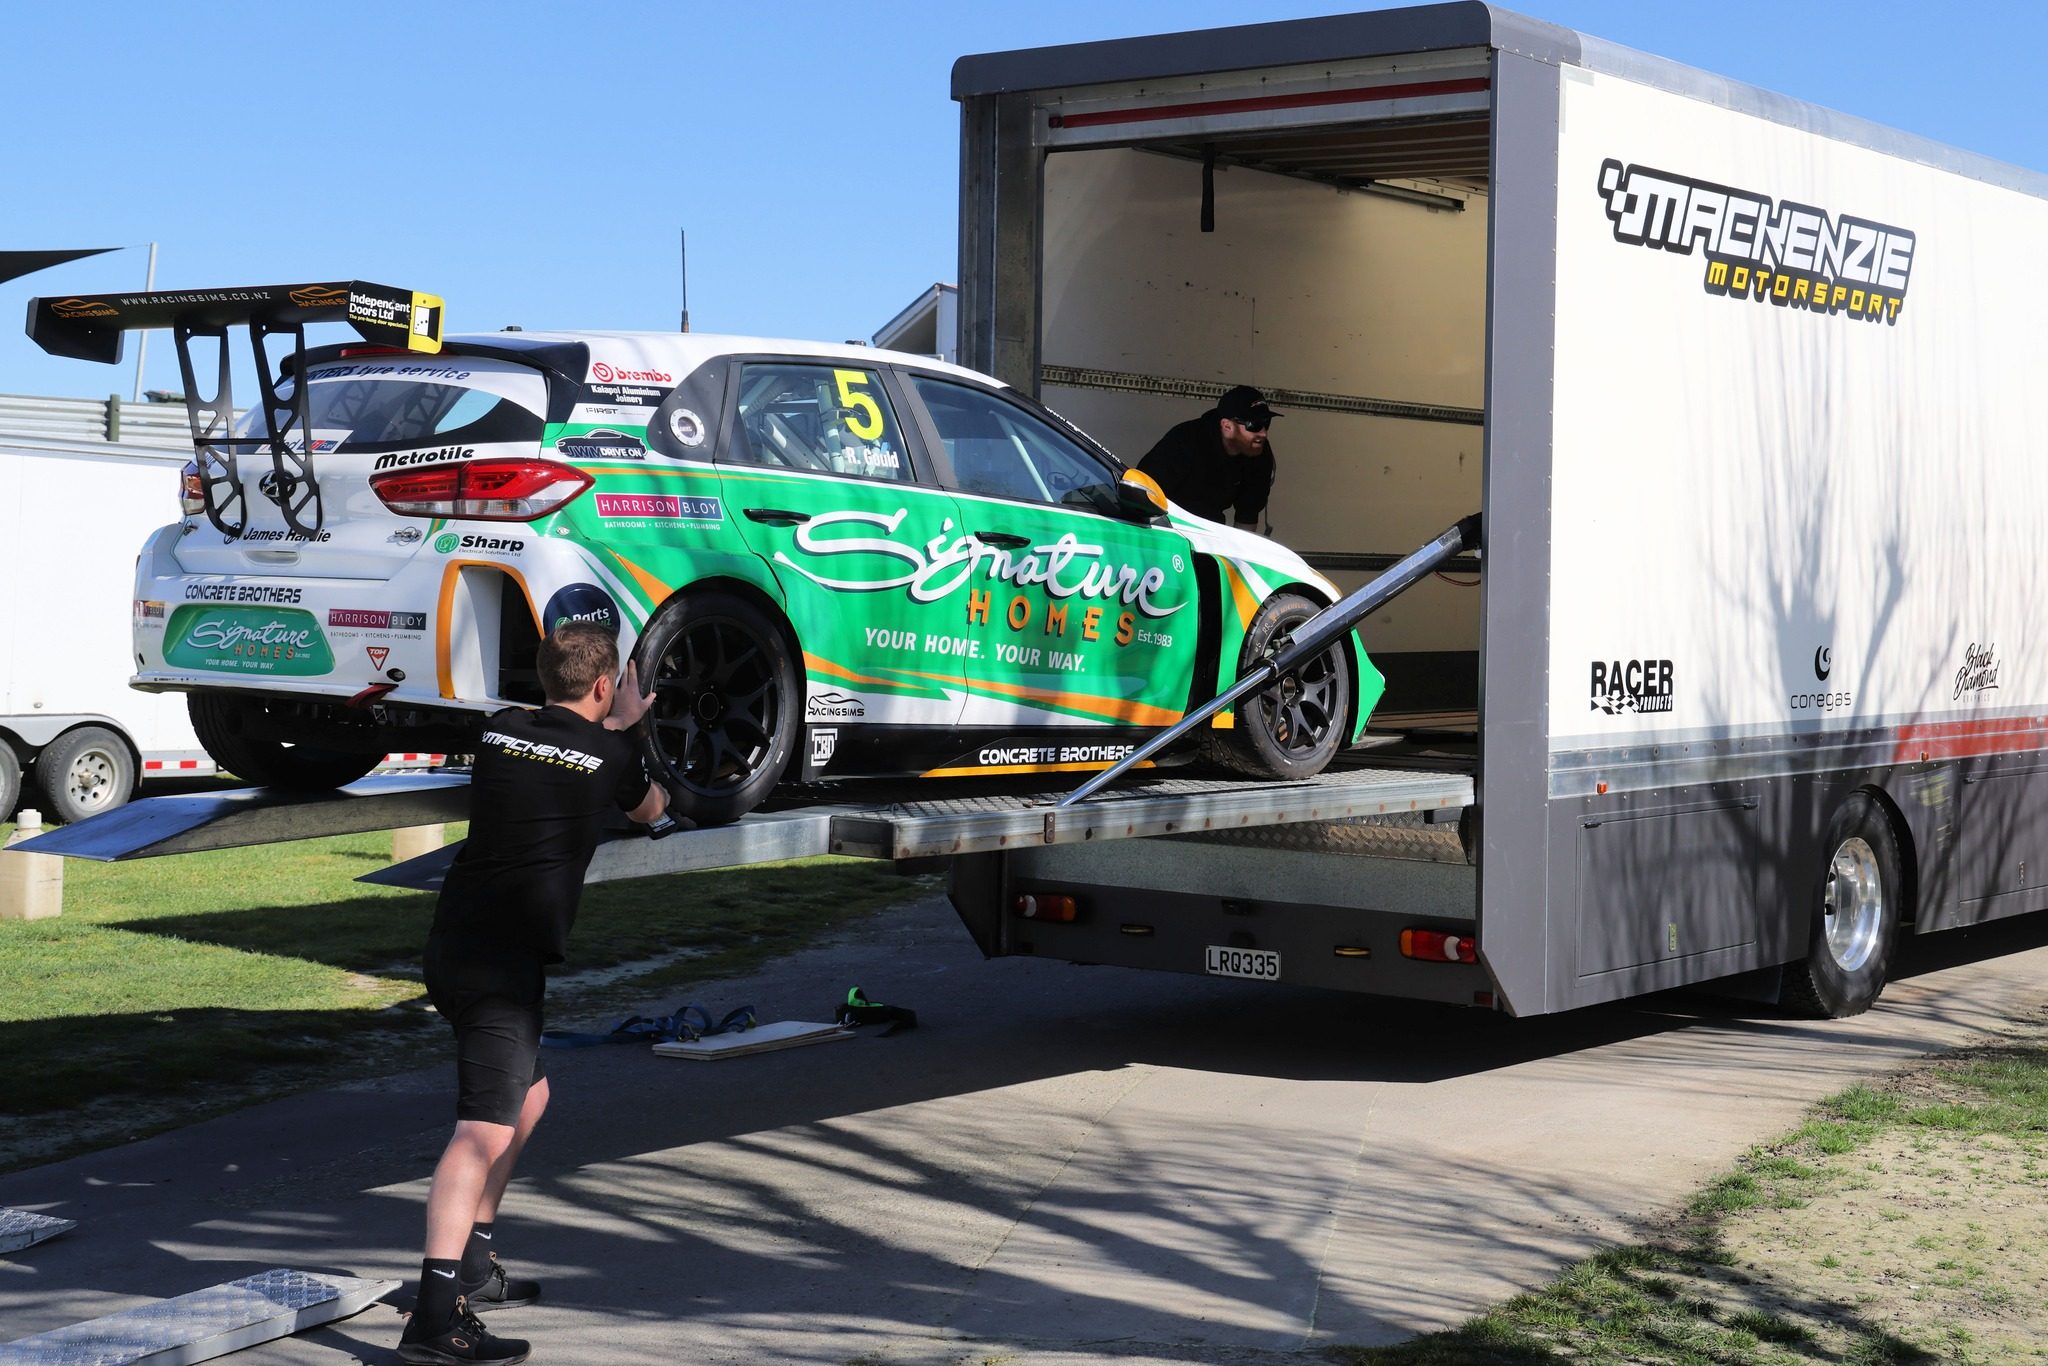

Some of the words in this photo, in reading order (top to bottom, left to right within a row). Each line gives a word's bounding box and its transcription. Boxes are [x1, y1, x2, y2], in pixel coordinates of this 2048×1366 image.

[1603, 167, 1913, 290] MACKENZIE
[121, 292, 271, 306] WWW.RACINGSIMS.CO.NZ
[1707, 261, 1900, 319] MOTORSPORT
[349, 302, 378, 317] Doors
[378, 308, 395, 320] Ltd
[356, 365, 395, 377] tyre
[398, 366, 471, 380] service
[615, 367, 672, 382] brembo
[615, 394, 643, 404] Joinery
[621, 386, 661, 397] Aluminium
[833, 369, 884, 440] 5
[374, 446, 475, 471] Metrotile
[600, 447, 627, 457] DRIVE
[627, 448, 642, 457] ON
[845, 446, 861, 464] R.
[863, 448, 900, 468] Gould
[600, 499, 676, 512] HARRISON
[682, 502, 716, 514] BLOY
[243, 528, 284, 540] James
[690, 522, 720, 530] PLUMBING
[460, 535, 525, 552] Sharp
[772, 508, 1188, 617] Signature
[185, 584, 237, 600] CONCRETE
[238, 586, 302, 603] BROTHERS
[331, 612, 386, 625] HARRISON
[391, 615, 423, 626] BLOY
[966, 589, 1136, 646] HOMES
[187, 619, 318, 650] Signature
[1137, 629, 1173, 647] Est.1983
[234, 643, 296, 660] HOMES
[865, 627, 917, 651] YOUR
[924, 634, 985, 659] HOME.
[995, 643, 1041, 666] YOUR
[1048, 650, 1086, 673] WAY.
[1965, 642, 1995, 673] Black
[260, 662, 275, 670] WAY.
[1590, 659, 1674, 697] RACER
[1953, 660, 2000, 700] Diamond
[1639, 694, 1673, 713] PRODUCTS
[1790, 691, 1852, 712] coregas
[808, 707, 865, 716] RACINGSIMS
[481, 731, 604, 771] MACKENZIE
[814, 735, 835, 760] CBD
[978, 747, 1056, 764] CONCRETE
[1059, 745, 1135, 762] BROTHERS
[502, 748, 594, 775] MOTORSPORT
[1207, 949, 1279, 978] LRQ335
